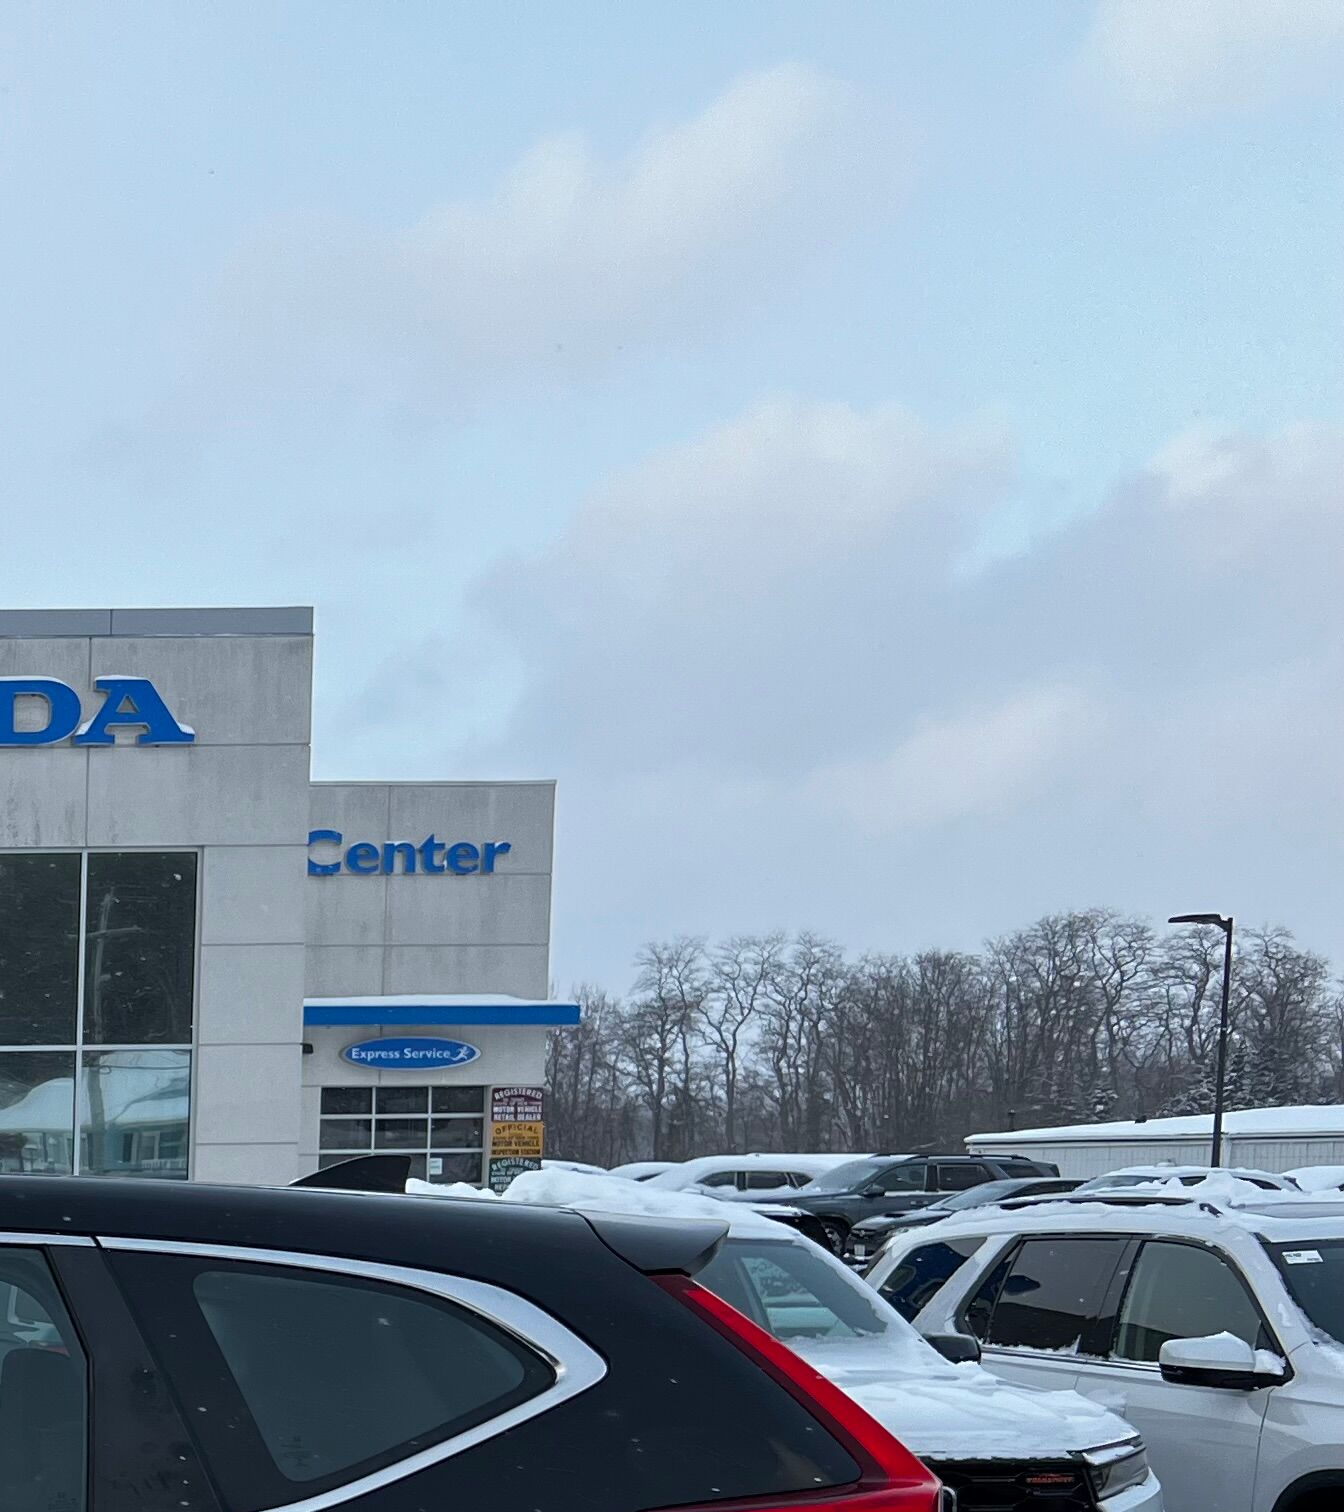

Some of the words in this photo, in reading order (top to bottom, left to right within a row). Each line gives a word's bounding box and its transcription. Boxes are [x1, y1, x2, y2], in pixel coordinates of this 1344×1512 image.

[307, 829, 512, 876] Center
[351, 1047, 401, 1062] Express
[403, 1047, 452, 1060] Service
[494, 1087, 543, 1100] REGISTERED
[517, 1105, 543, 1113] VEHICLE
[495, 1123, 538, 1135] OFFICIAL
[492, 1157, 539, 1170] REGISTERED
